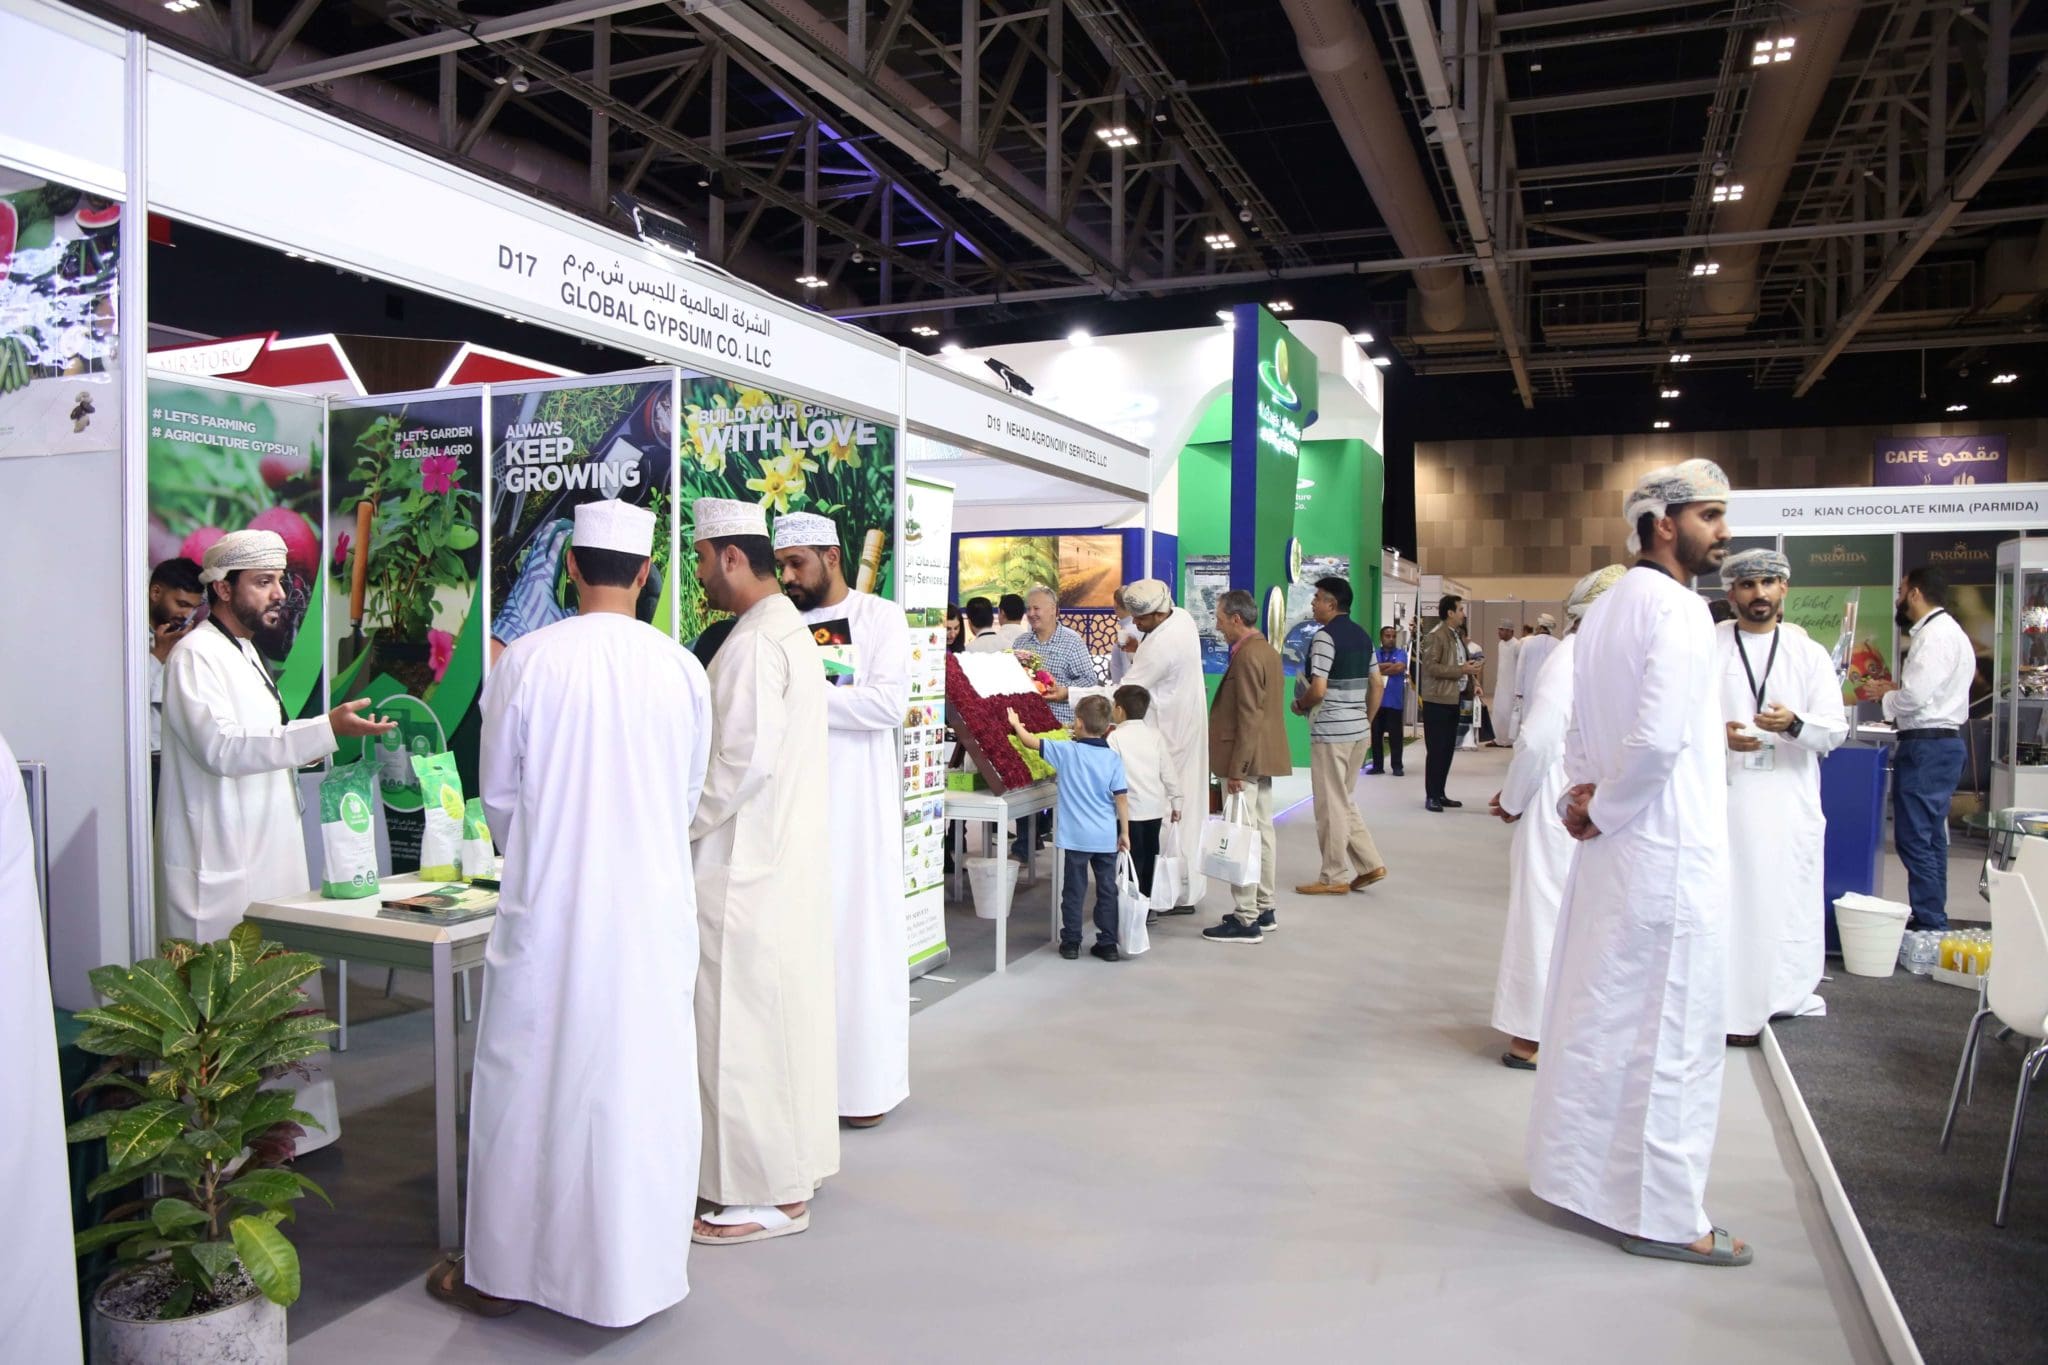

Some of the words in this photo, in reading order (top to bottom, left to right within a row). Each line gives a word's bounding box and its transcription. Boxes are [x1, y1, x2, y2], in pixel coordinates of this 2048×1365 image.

[498, 244, 538, 278] D17
[628, 277, 677, 304] للجبس
[679, 287, 730, 322] العالمية
[560, 281, 639, 327] GLOBAL
[643, 309, 713, 350] GYPSUM
[715, 334, 742, 360] CO.
[745, 343, 773, 369] LLC
[731, 307, 772, 338] الشركة
[164, 409, 200, 425] LET'S
[201, 415, 257, 434] FARMING
[700, 406, 746, 425] BUILD
[749, 403, 798, 421] YOUR
[164, 428, 250, 450] AGRICULTURE
[251, 440, 299, 457] GYPSUM
[403, 429, 430, 442] LET'S
[430, 425, 473, 440] GARDEN
[505, 420, 563, 439] ALWAYS
[698, 421, 782, 455] WITH
[790, 417, 878, 450] LOVE
[987, 414, 1001, 432] D19
[1006, 420, 1031, 441] NEHAD
[1031, 430, 1068, 454] AGRONOMY
[1068, 443, 1097, 464] SERVICES
[1096, 453, 1108, 468] LLC
[402, 445, 442, 459] GLOBAL
[443, 443, 473, 457] AGRO
[505, 436, 574, 466] KEEP
[1885, 449, 1929, 464] CAFE
[1937, 446, 2000, 467] مقهى
[505, 460, 641, 494] GROWING
[1782, 508, 1804, 518] D24
[1814, 506, 1844, 517] KIAN
[1847, 504, 1925, 516] CHOCOLATE
[1928, 503, 1965, 514] KIMIA
[1968, 501, 2040, 515] (PARMIDA)
[1810, 551, 1868, 563] PARMIDA
[1929, 550, 1991, 561] PARMIDA
